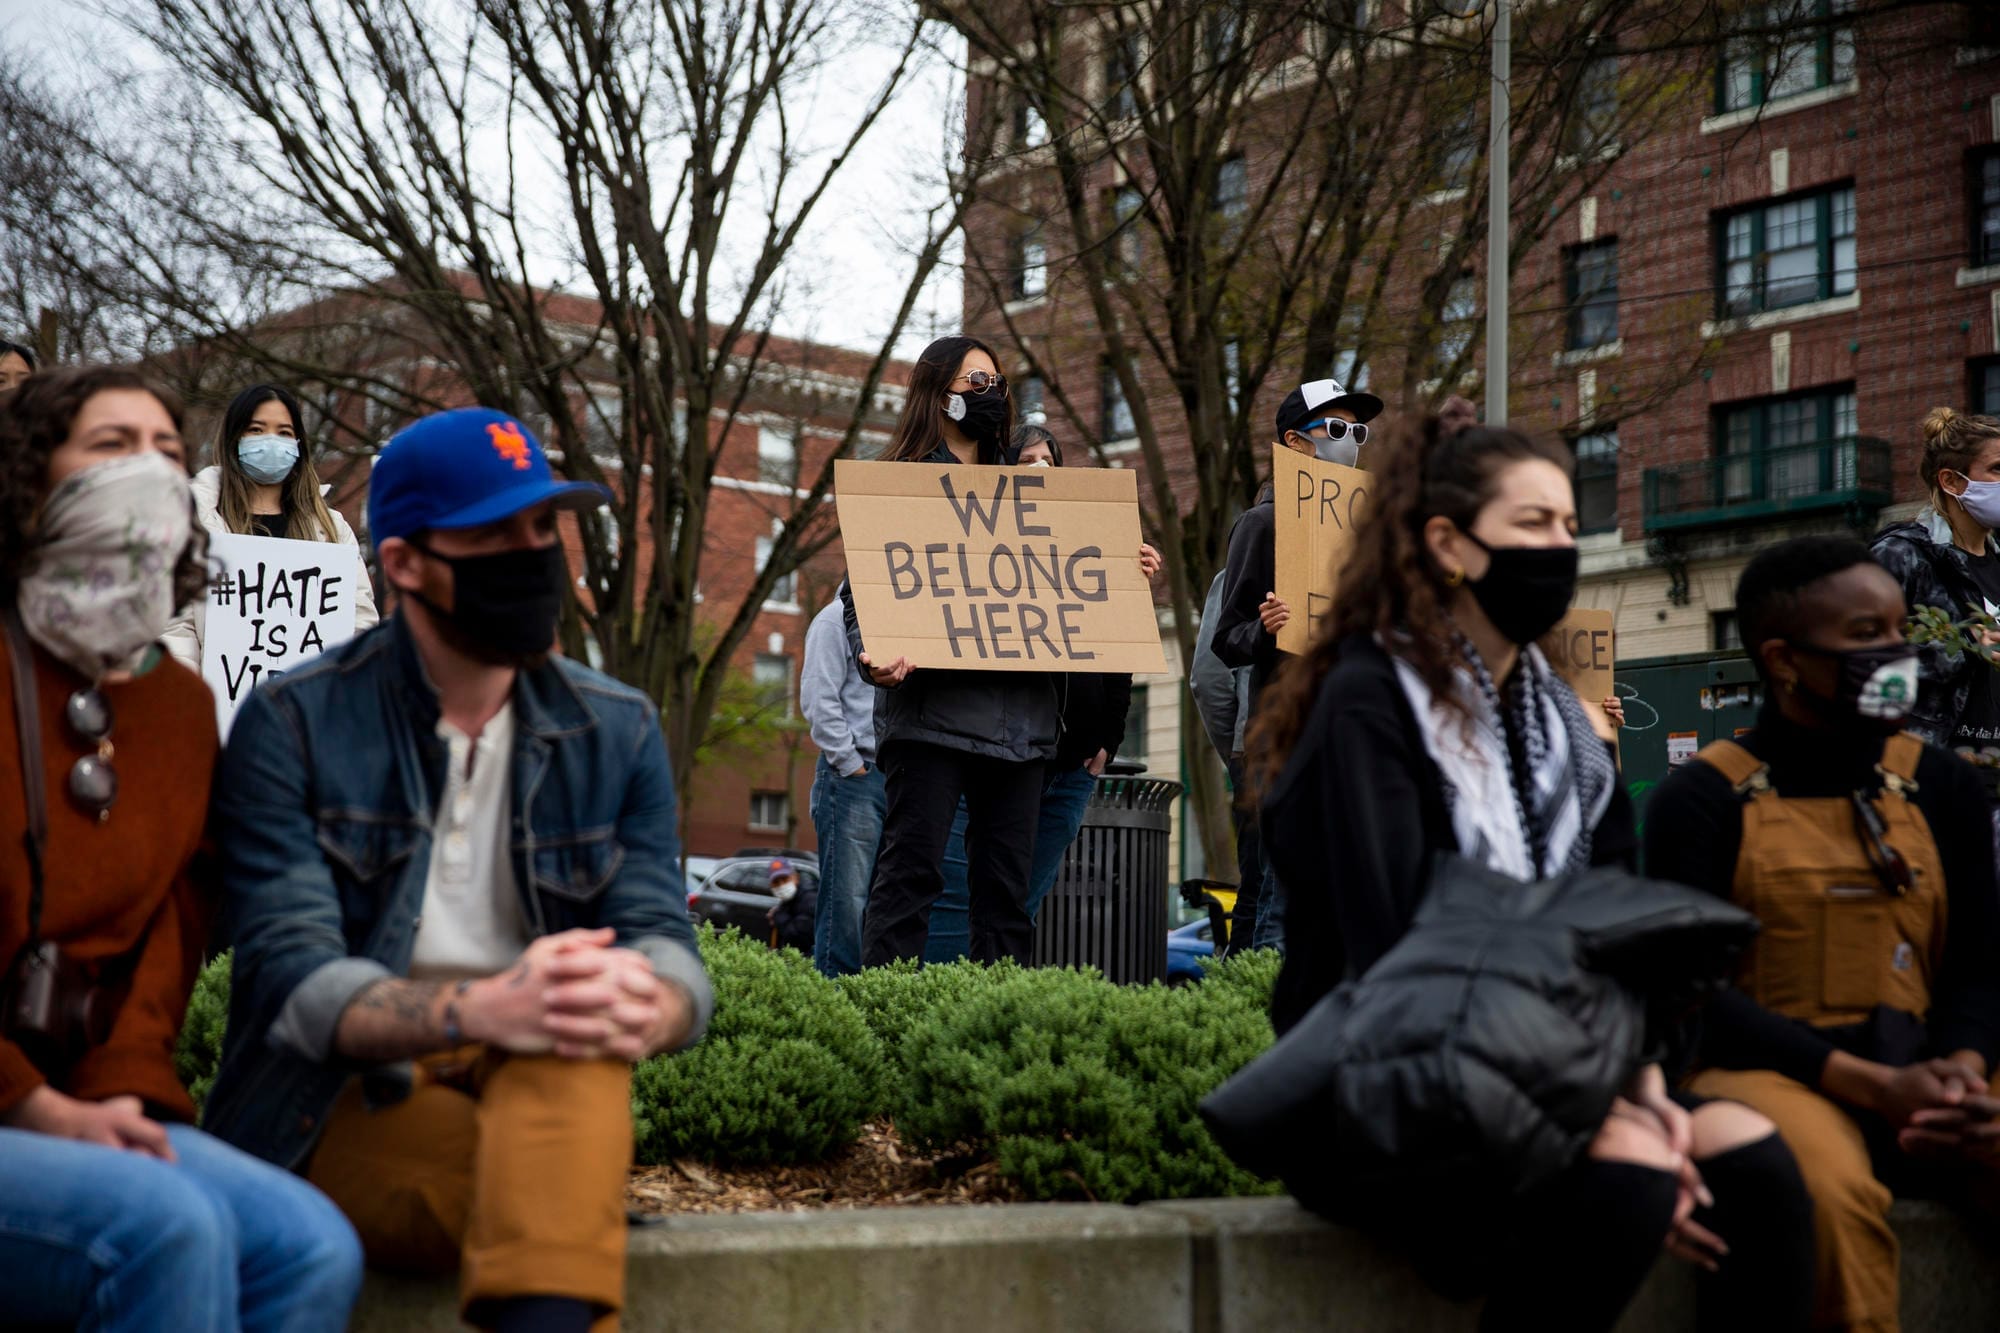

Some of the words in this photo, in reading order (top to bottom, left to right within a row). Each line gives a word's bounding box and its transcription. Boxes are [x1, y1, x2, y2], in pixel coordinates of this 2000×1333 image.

[939, 472, 1052, 538] WE
[211, 562, 342, 618] #HATE
[884, 541, 1109, 602] BELONG
[249, 619, 288, 658] IS
[299, 620, 324, 654] A
[942, 603, 1097, 660] HERE
